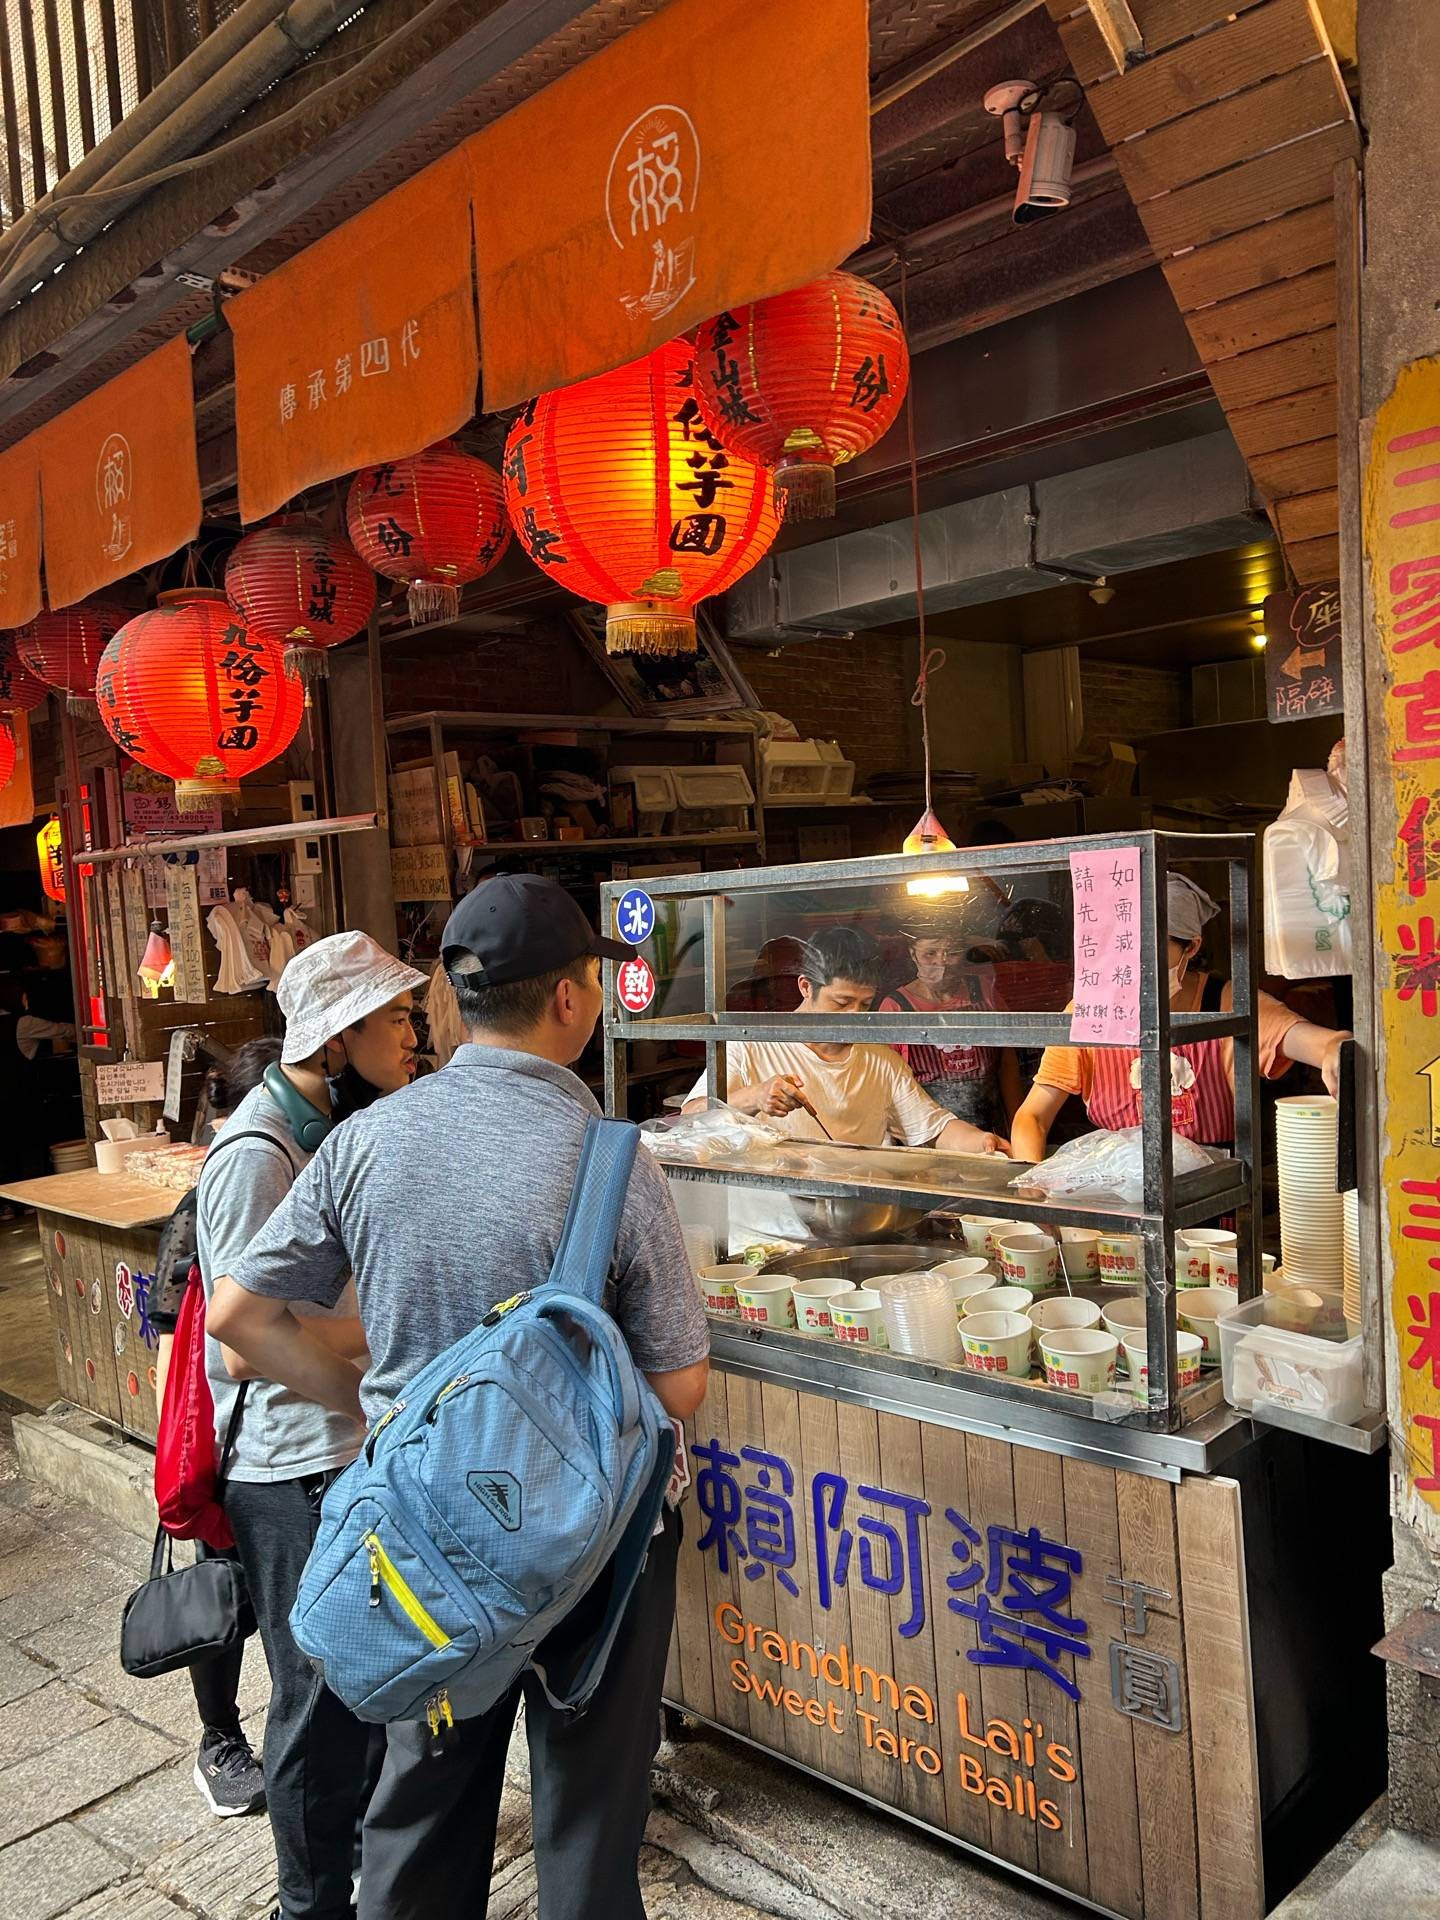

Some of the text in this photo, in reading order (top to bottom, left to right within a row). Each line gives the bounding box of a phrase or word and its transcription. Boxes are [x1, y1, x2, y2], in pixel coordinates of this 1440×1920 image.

[279, 319, 420, 425] 傳承第四代
[710, 312, 762, 426] 金山城
[370, 463, 414, 557] 九份
[218, 623, 270, 751] 九份芋圓
[1276, 676, 1336, 716] 隔壁
[623, 897, 649, 936] 冰
[1074, 867, 1100, 989] 請先告知
[1109, 860, 1134, 989] 如需減糖
[624, 962, 649, 1005] 熱
[691, 1439, 1091, 1701] 賴阿婆
[715, 1602, 1077, 1783] Grandma Lai's
[731, 1660, 1062, 1831] Sweet Taro Balls
